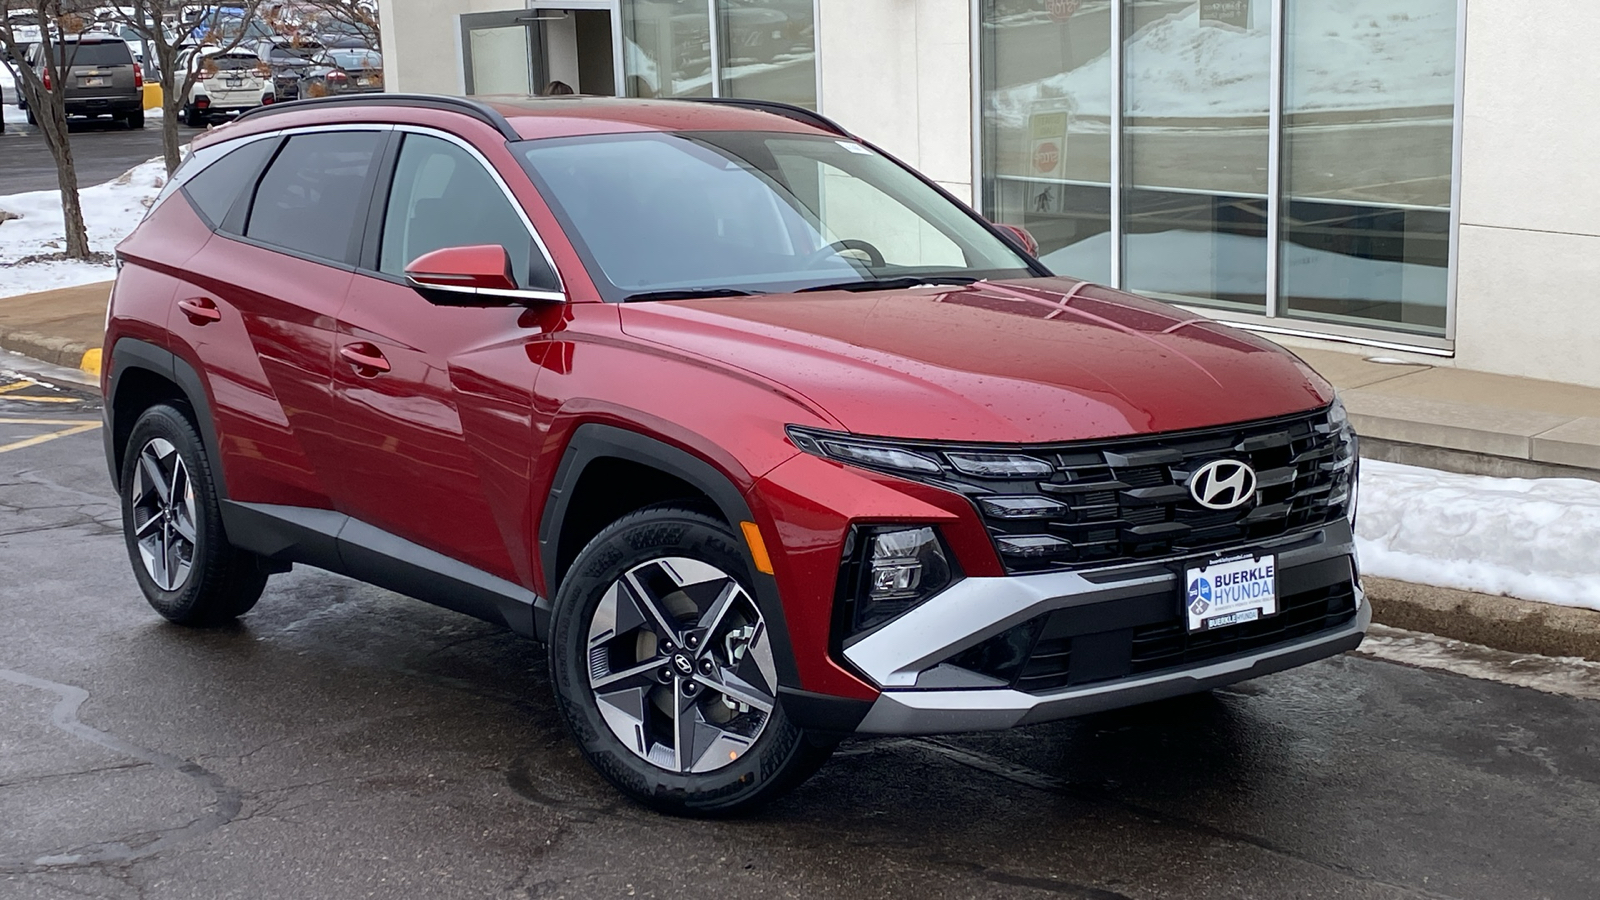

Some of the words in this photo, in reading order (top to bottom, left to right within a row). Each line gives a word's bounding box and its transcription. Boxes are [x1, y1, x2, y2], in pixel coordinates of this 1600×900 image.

[1215, 566, 1273, 588] BUERKLE
[1215, 579, 1275, 606] HYUNDAI
[1209, 614, 1236, 628] BUERKLE
